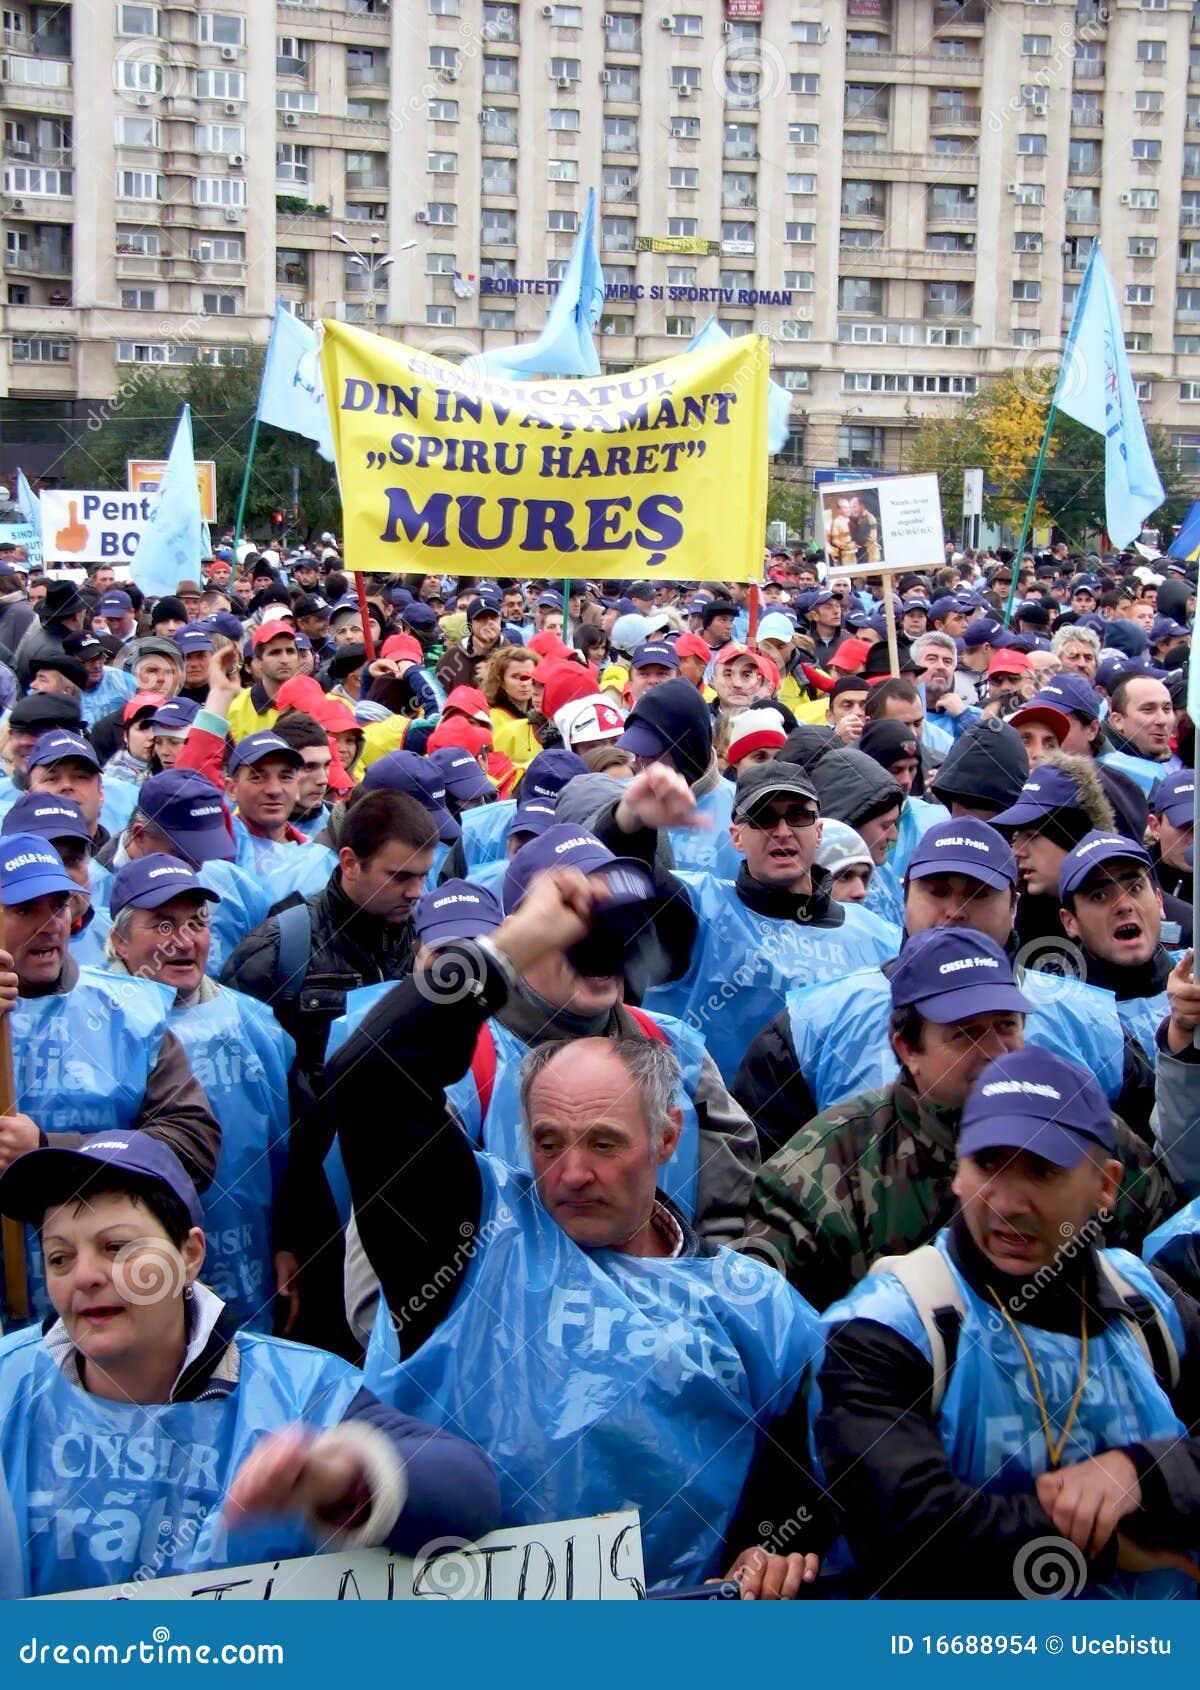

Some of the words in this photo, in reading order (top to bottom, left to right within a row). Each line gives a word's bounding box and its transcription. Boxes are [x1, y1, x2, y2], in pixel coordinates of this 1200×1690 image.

[650, 285, 663, 300] SI
[669, 286, 733, 304] SPORTIV
[738, 289, 792, 306] ROMAN
[341, 378, 422, 420] DIN
[408, 358, 677, 408] SINDICATUL
[83, 495, 151, 521] Pent
[380, 487, 685, 566] MUREȘ
[100, 532, 141, 557] BO
[5, 853, 37, 872] CNSLR
[51, 1432, 220, 1492] CNSLR
